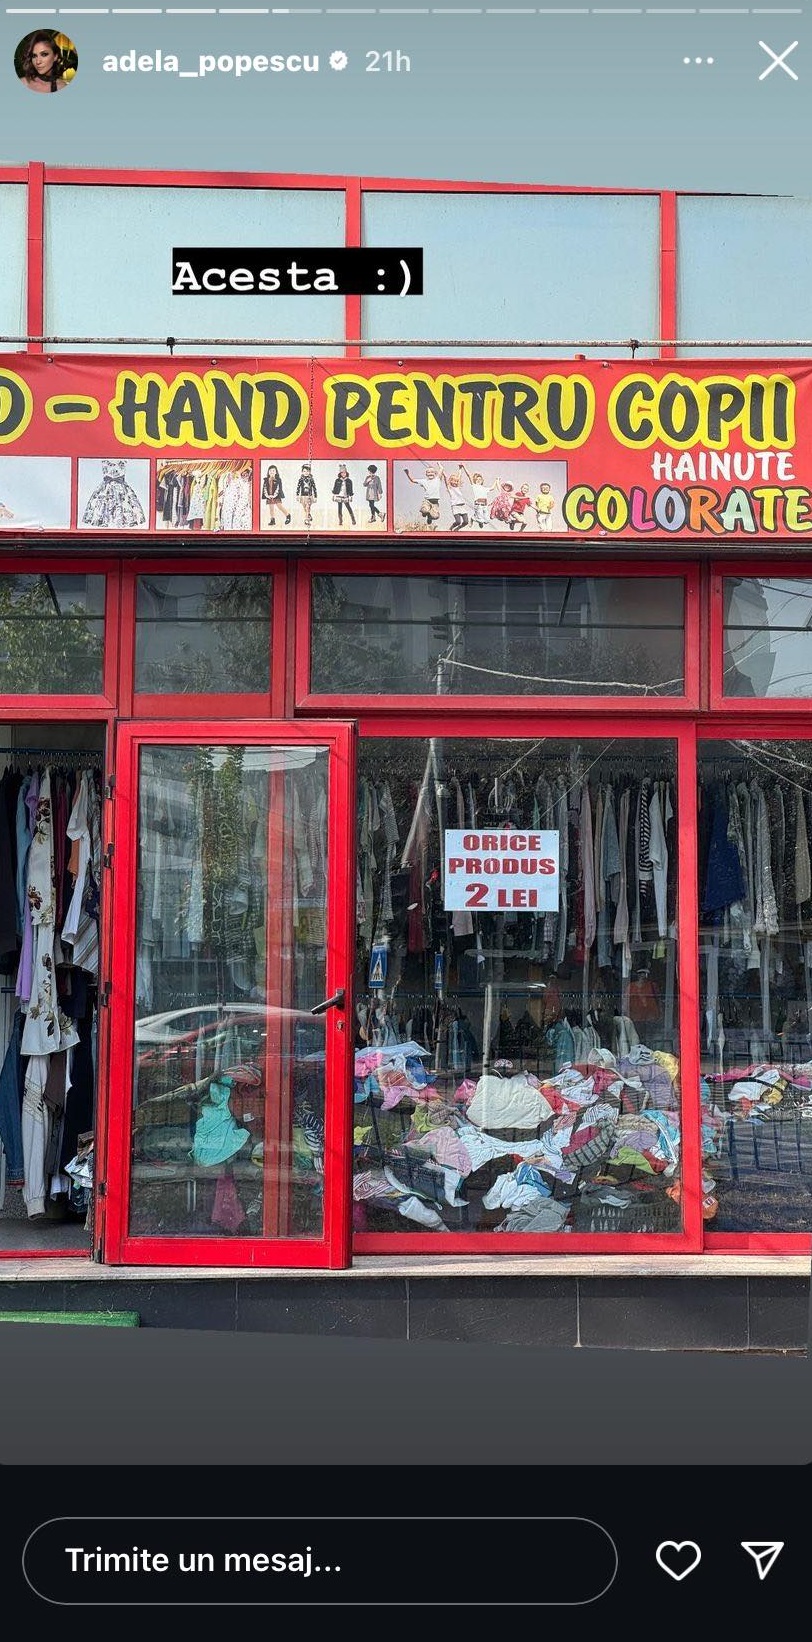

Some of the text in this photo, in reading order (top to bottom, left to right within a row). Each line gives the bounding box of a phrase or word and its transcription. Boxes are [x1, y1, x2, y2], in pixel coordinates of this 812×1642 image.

[114, 377, 301, 442] HAND
[329, 378, 590, 446] PENTRU
[613, 379, 790, 444] COPII
[650, 451, 797, 482] HAINUTE
[562, 484, 812, 536] COLORATE
[462, 834, 542, 852] ORICE
[448, 857, 557, 876] PRODUS
[464, 882, 538, 908] 2 LEI
